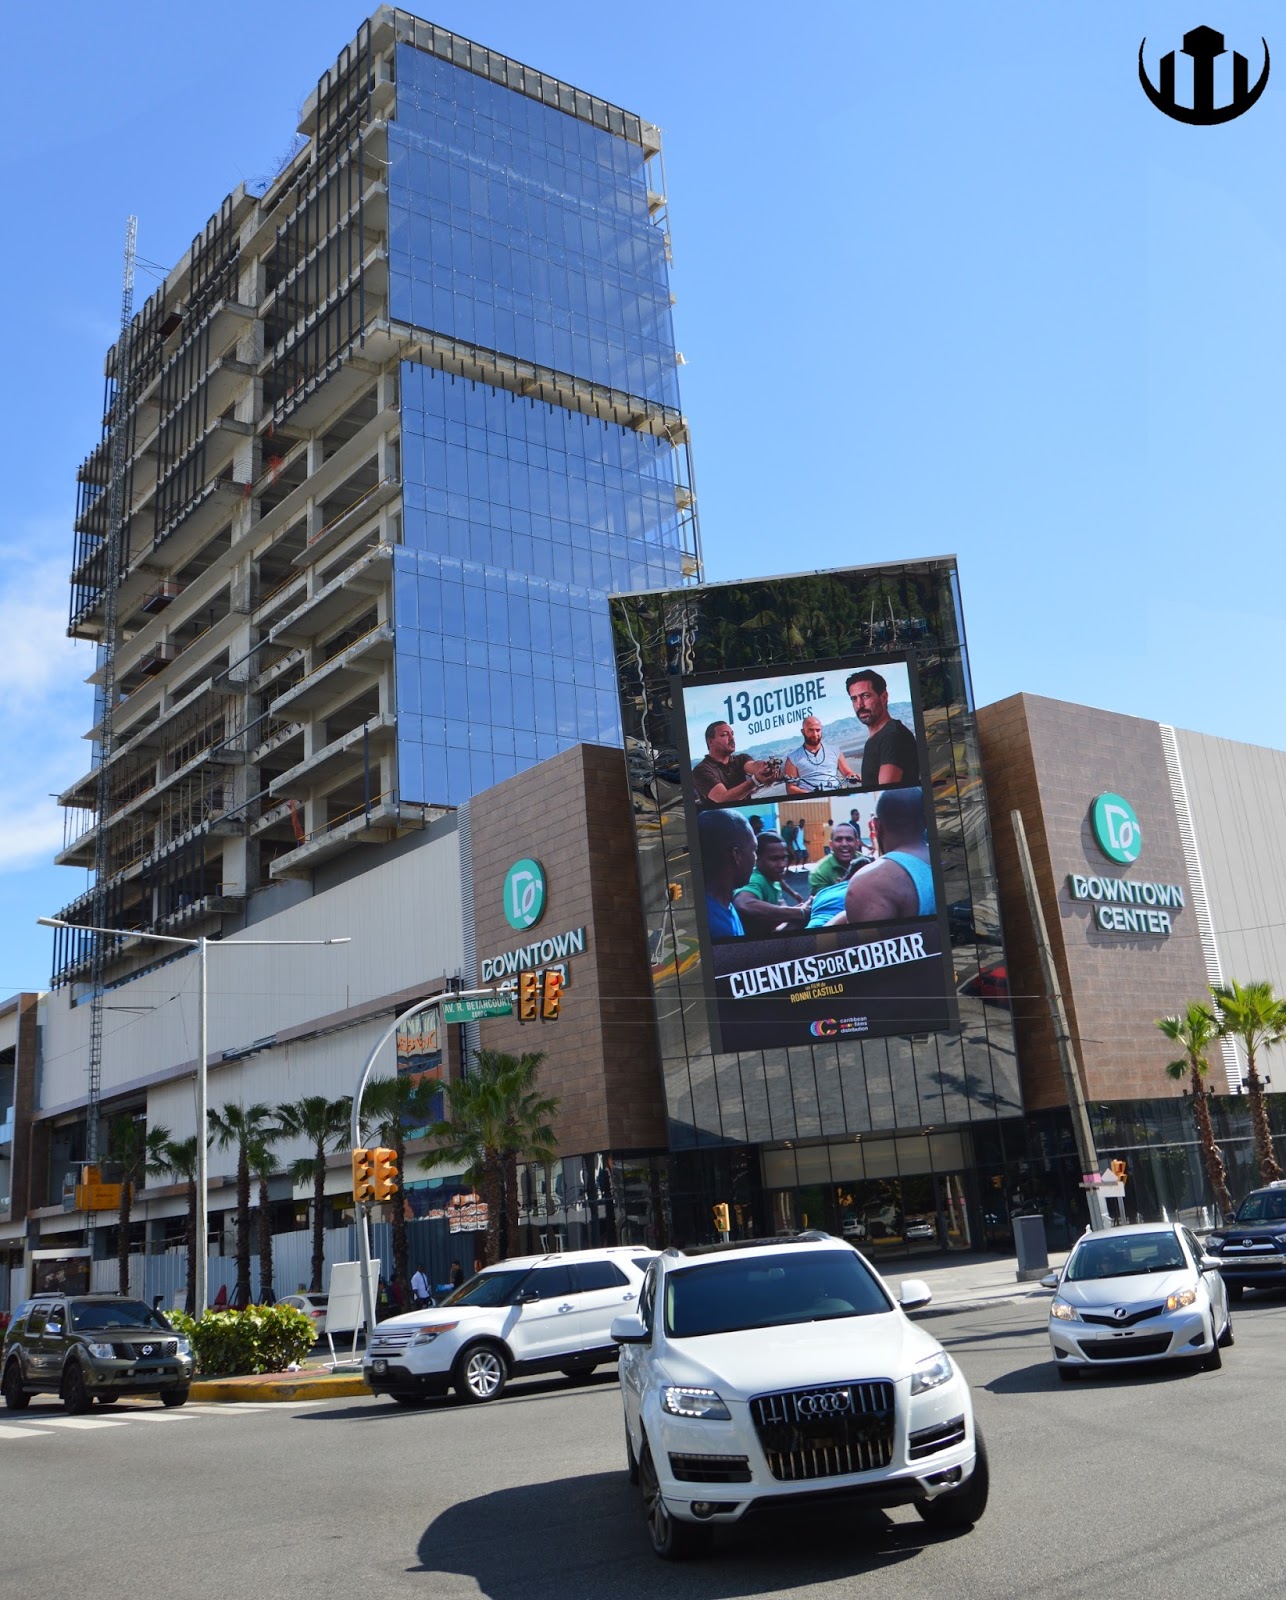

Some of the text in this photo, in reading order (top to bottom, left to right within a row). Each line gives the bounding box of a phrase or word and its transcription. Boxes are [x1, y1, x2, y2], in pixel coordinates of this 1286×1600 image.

[723, 676, 827, 725] 13 OCTUBRE
[748, 706, 814, 736] SOLO EN CINES
[1071, 874, 1185, 907] DOWNTOWN
[1099, 906, 1172, 934] CENTER
[481, 927, 585, 983] DOWNTOWN
[729, 933, 927, 999] CUENTAS POR COBRAR
[444, 997, 511, 1014] AV. R. BETANCOURT
[790, 983, 844, 1003] RONNI CASTILLO
[840, 1026, 869, 1034] distribution
